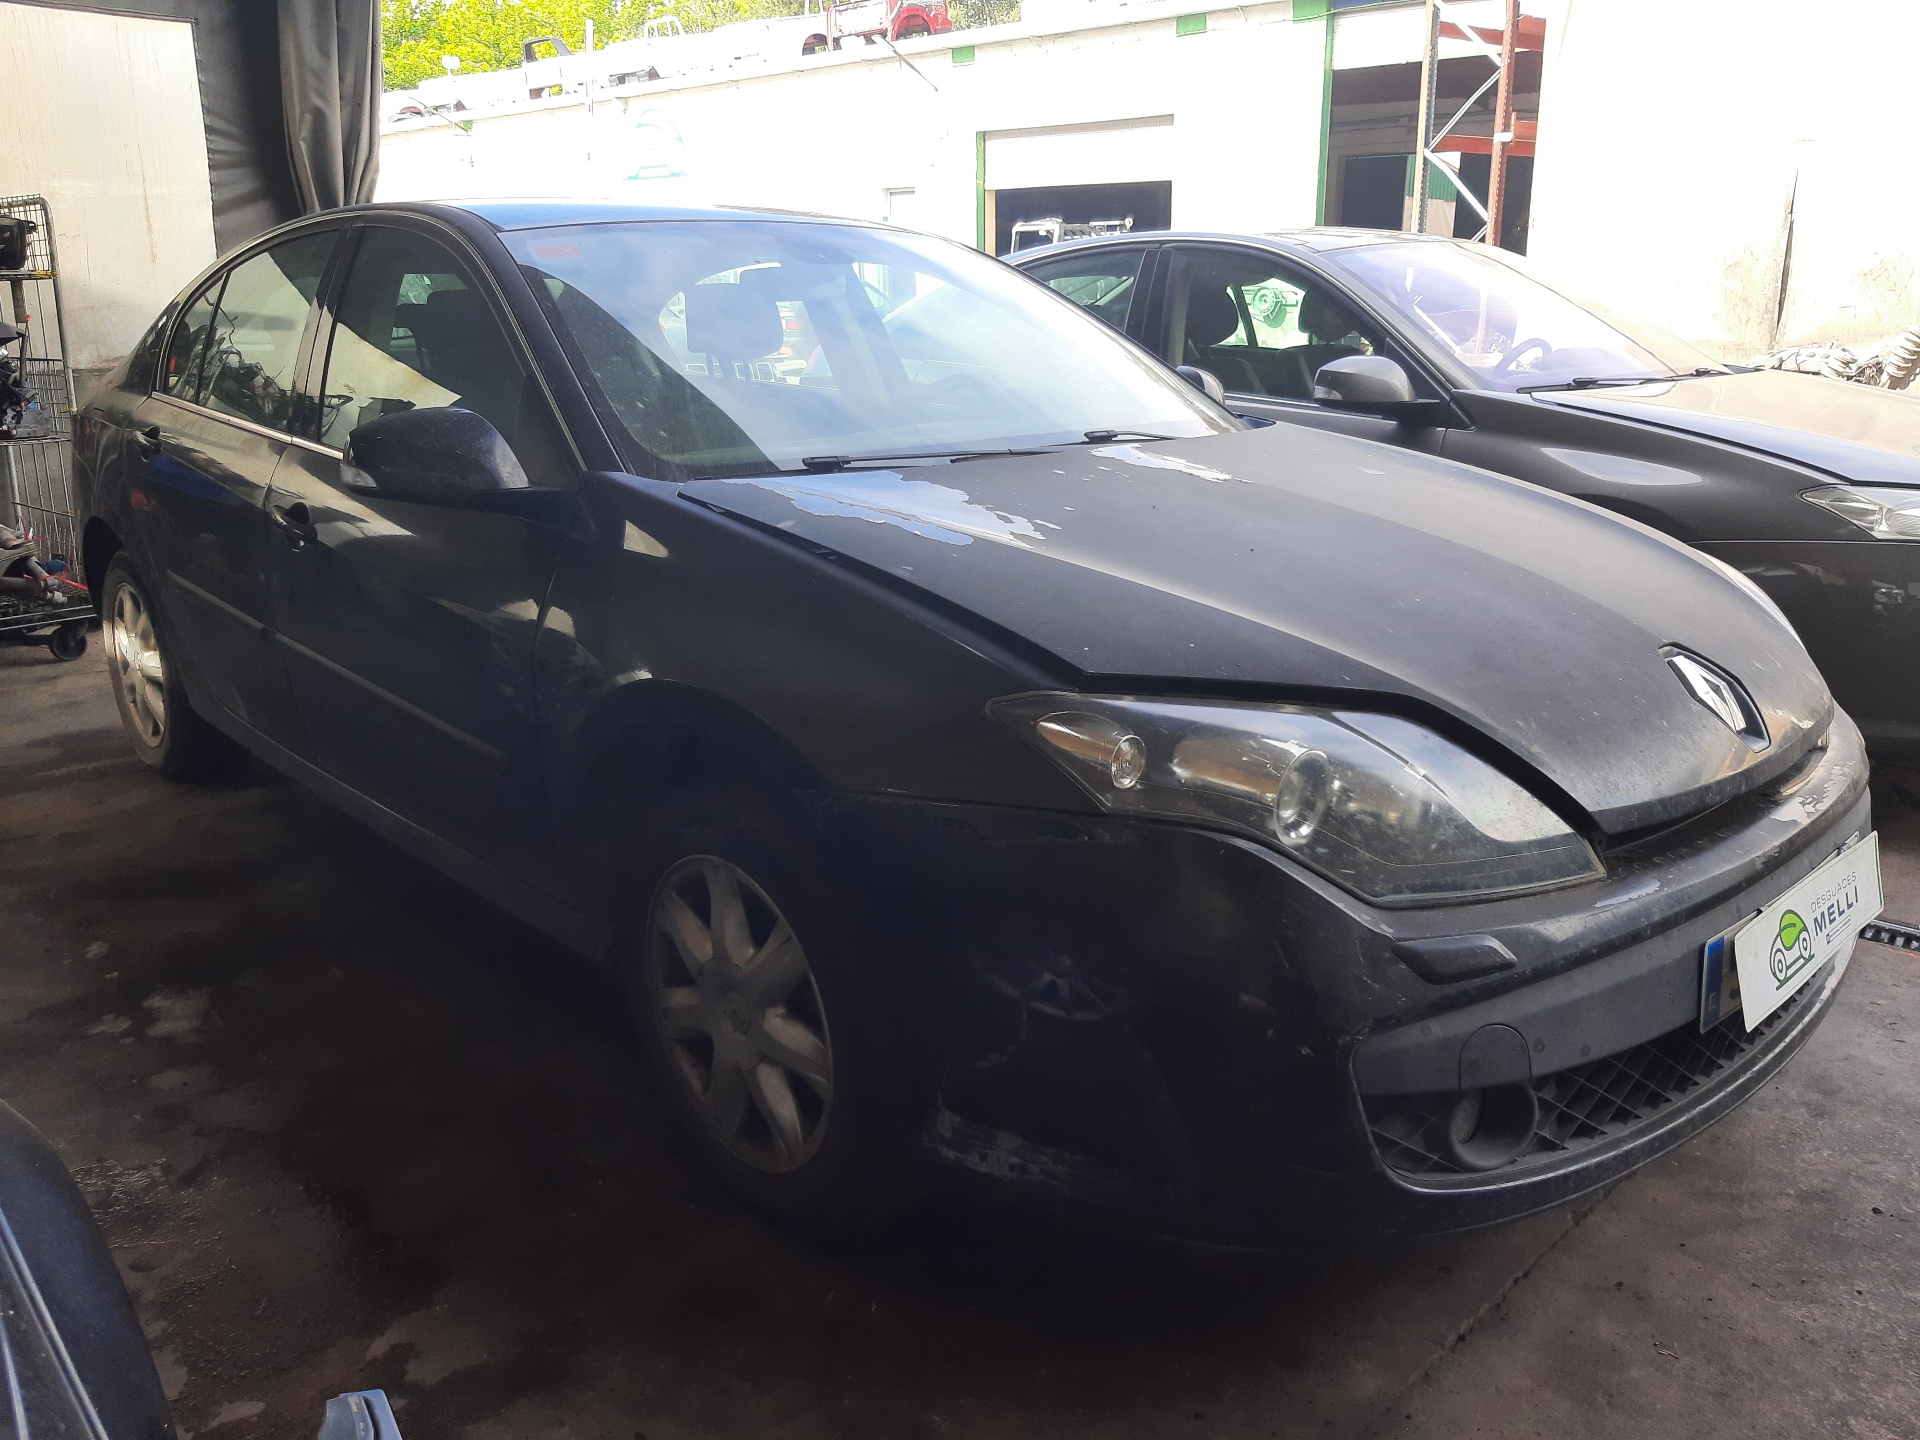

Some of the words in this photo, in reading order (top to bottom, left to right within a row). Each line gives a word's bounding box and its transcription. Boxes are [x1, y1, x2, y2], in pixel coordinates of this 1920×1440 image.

[1810, 871, 1857, 913] DESGUACES
[1813, 885, 1858, 937] MELLI
[1708, 991, 1717, 1012] E
